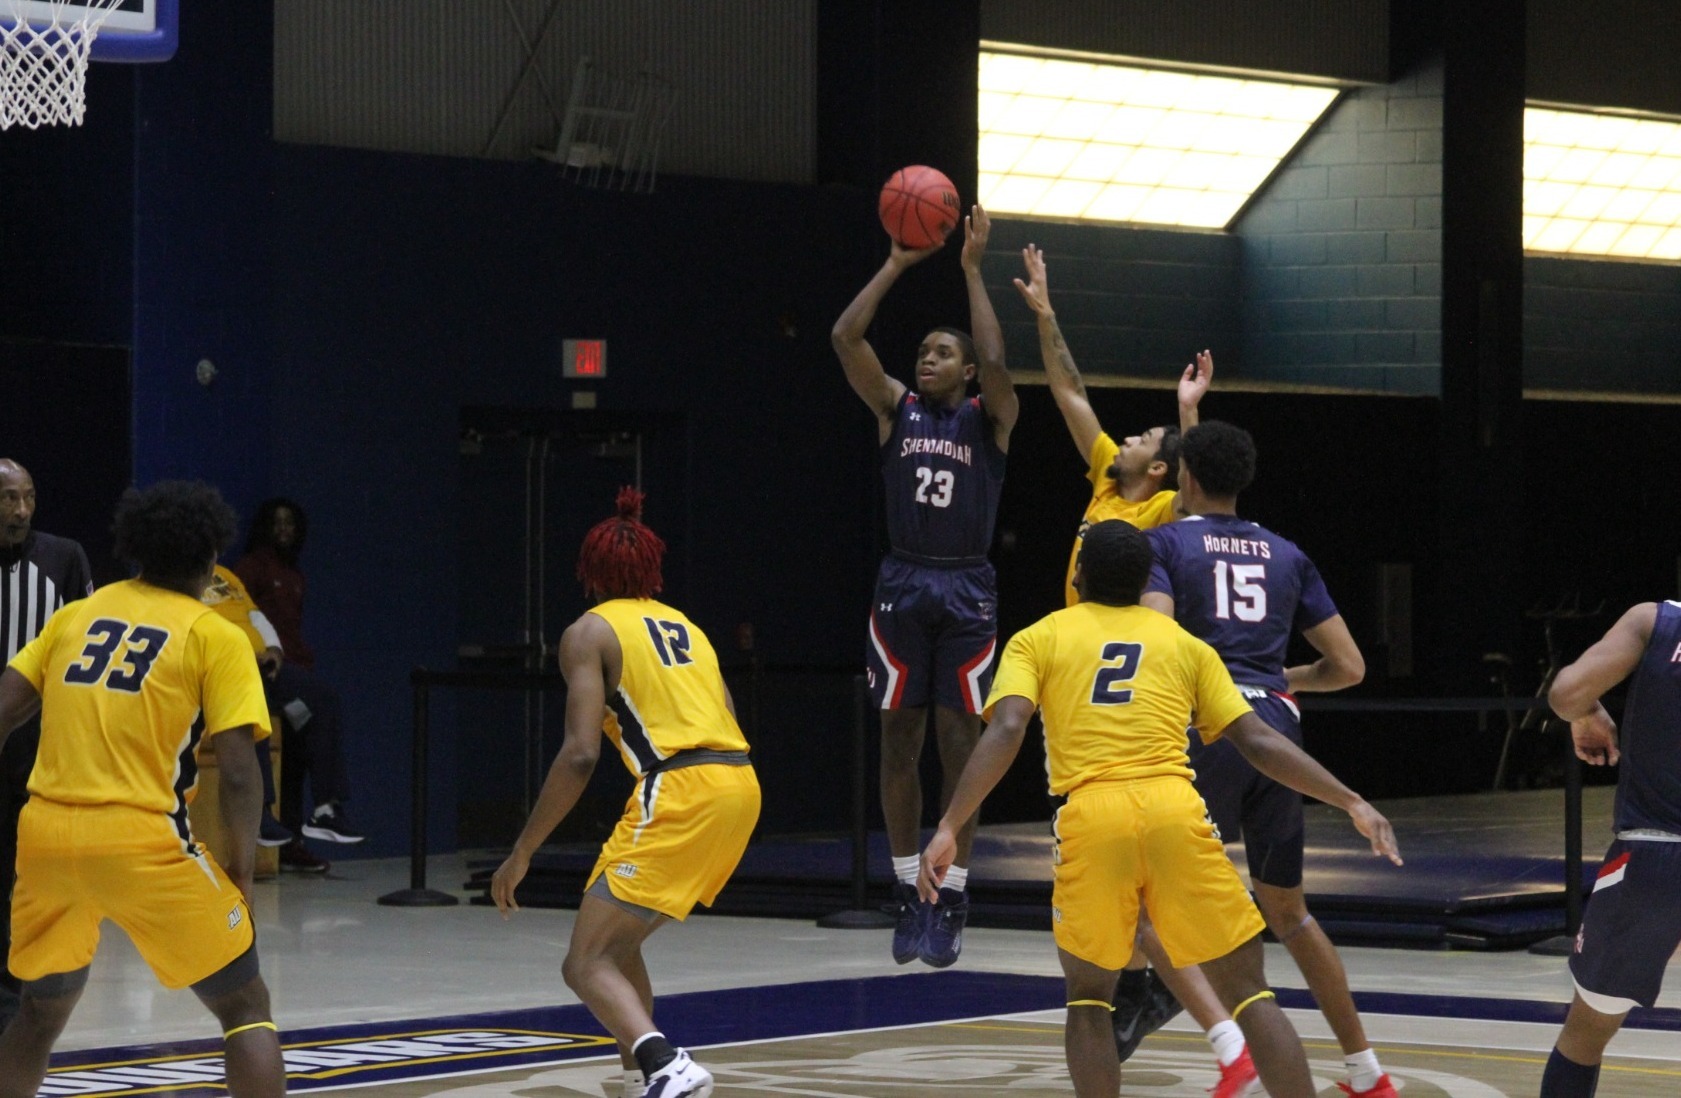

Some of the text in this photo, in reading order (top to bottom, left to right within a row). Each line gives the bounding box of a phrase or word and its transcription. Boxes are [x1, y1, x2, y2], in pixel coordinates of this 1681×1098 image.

[915, 466, 955, 508] 23
[1203, 534, 1271, 560] HORNETS
[1213, 560, 1267, 622] 15
[64, 618, 170, 693] 33
[643, 616, 694, 667] 12
[1090, 642, 1143, 705] 2
[35, 1031, 574, 1098] OUGARS
